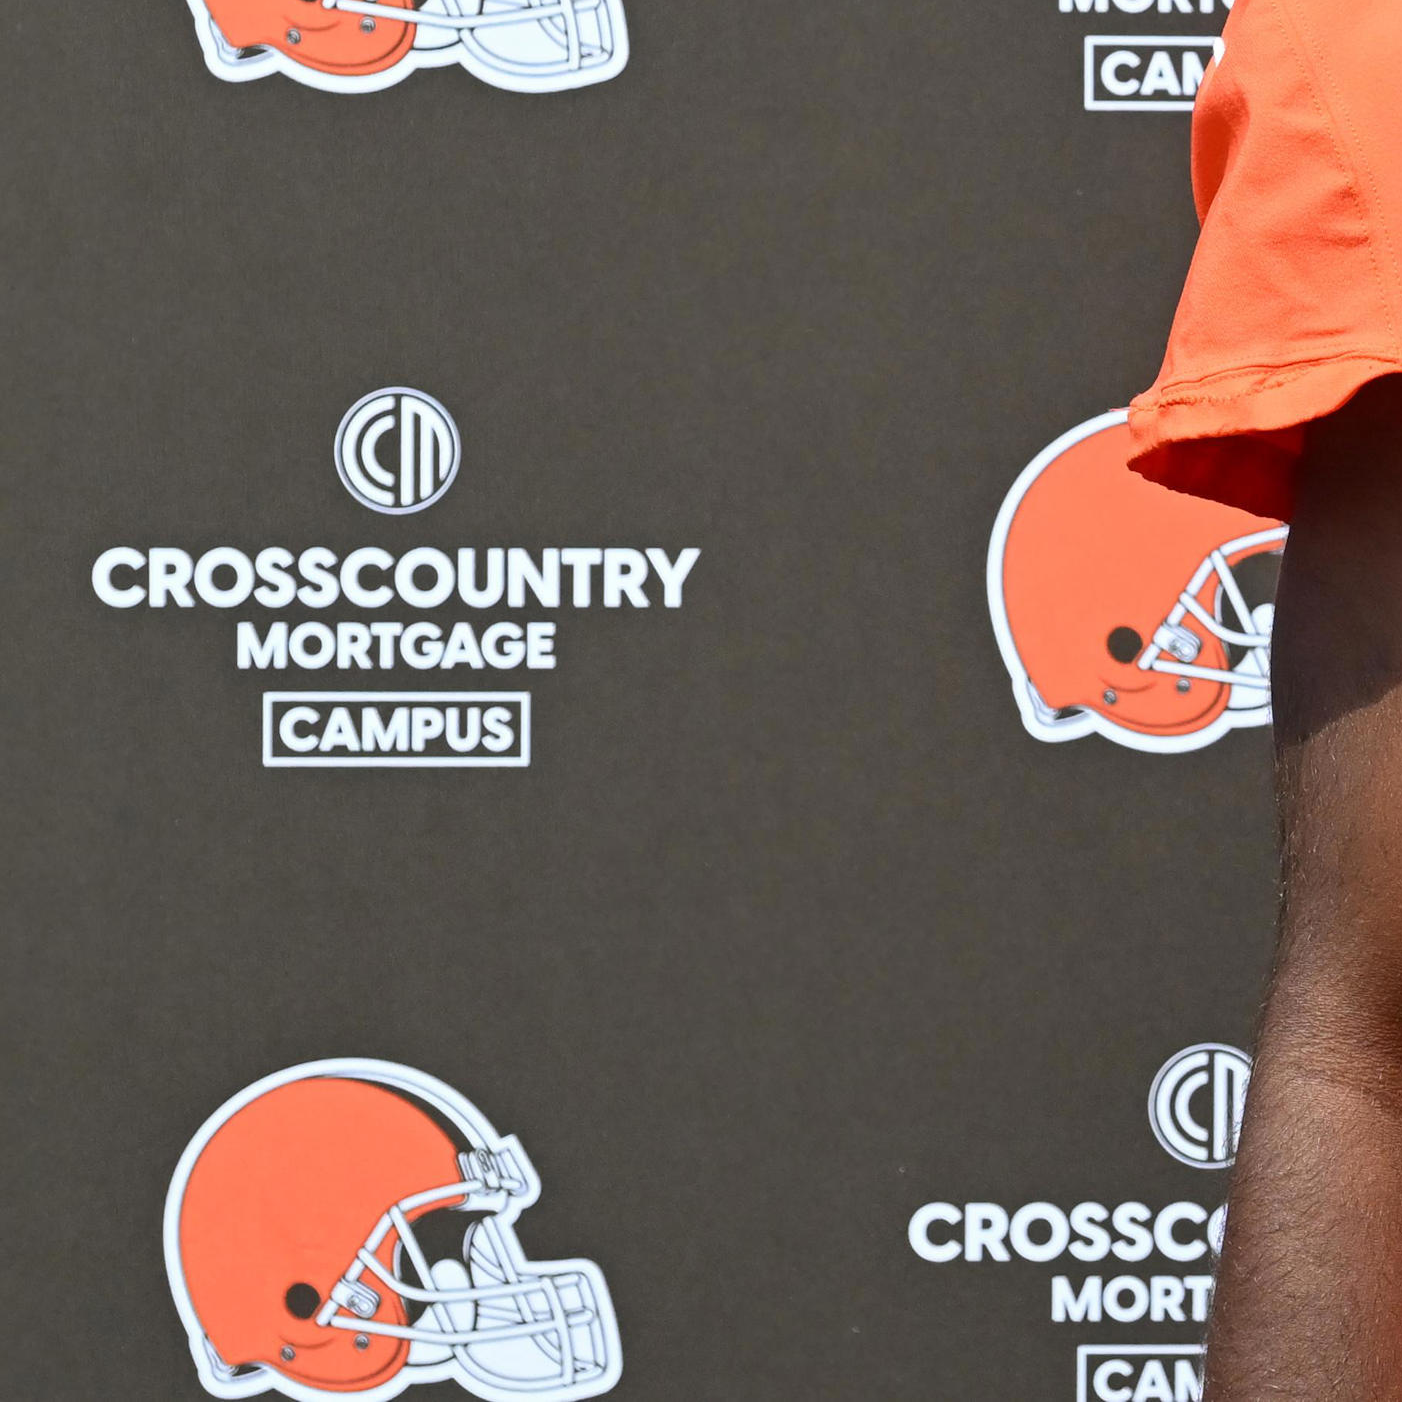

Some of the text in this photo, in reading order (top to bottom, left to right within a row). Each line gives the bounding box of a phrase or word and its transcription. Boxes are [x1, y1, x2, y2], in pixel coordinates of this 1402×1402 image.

[91, 546, 702, 609] CROSSCOUNTRY
[236, 621, 557, 670] MORTGAGE
[279, 706, 516, 753] CAMPUS
